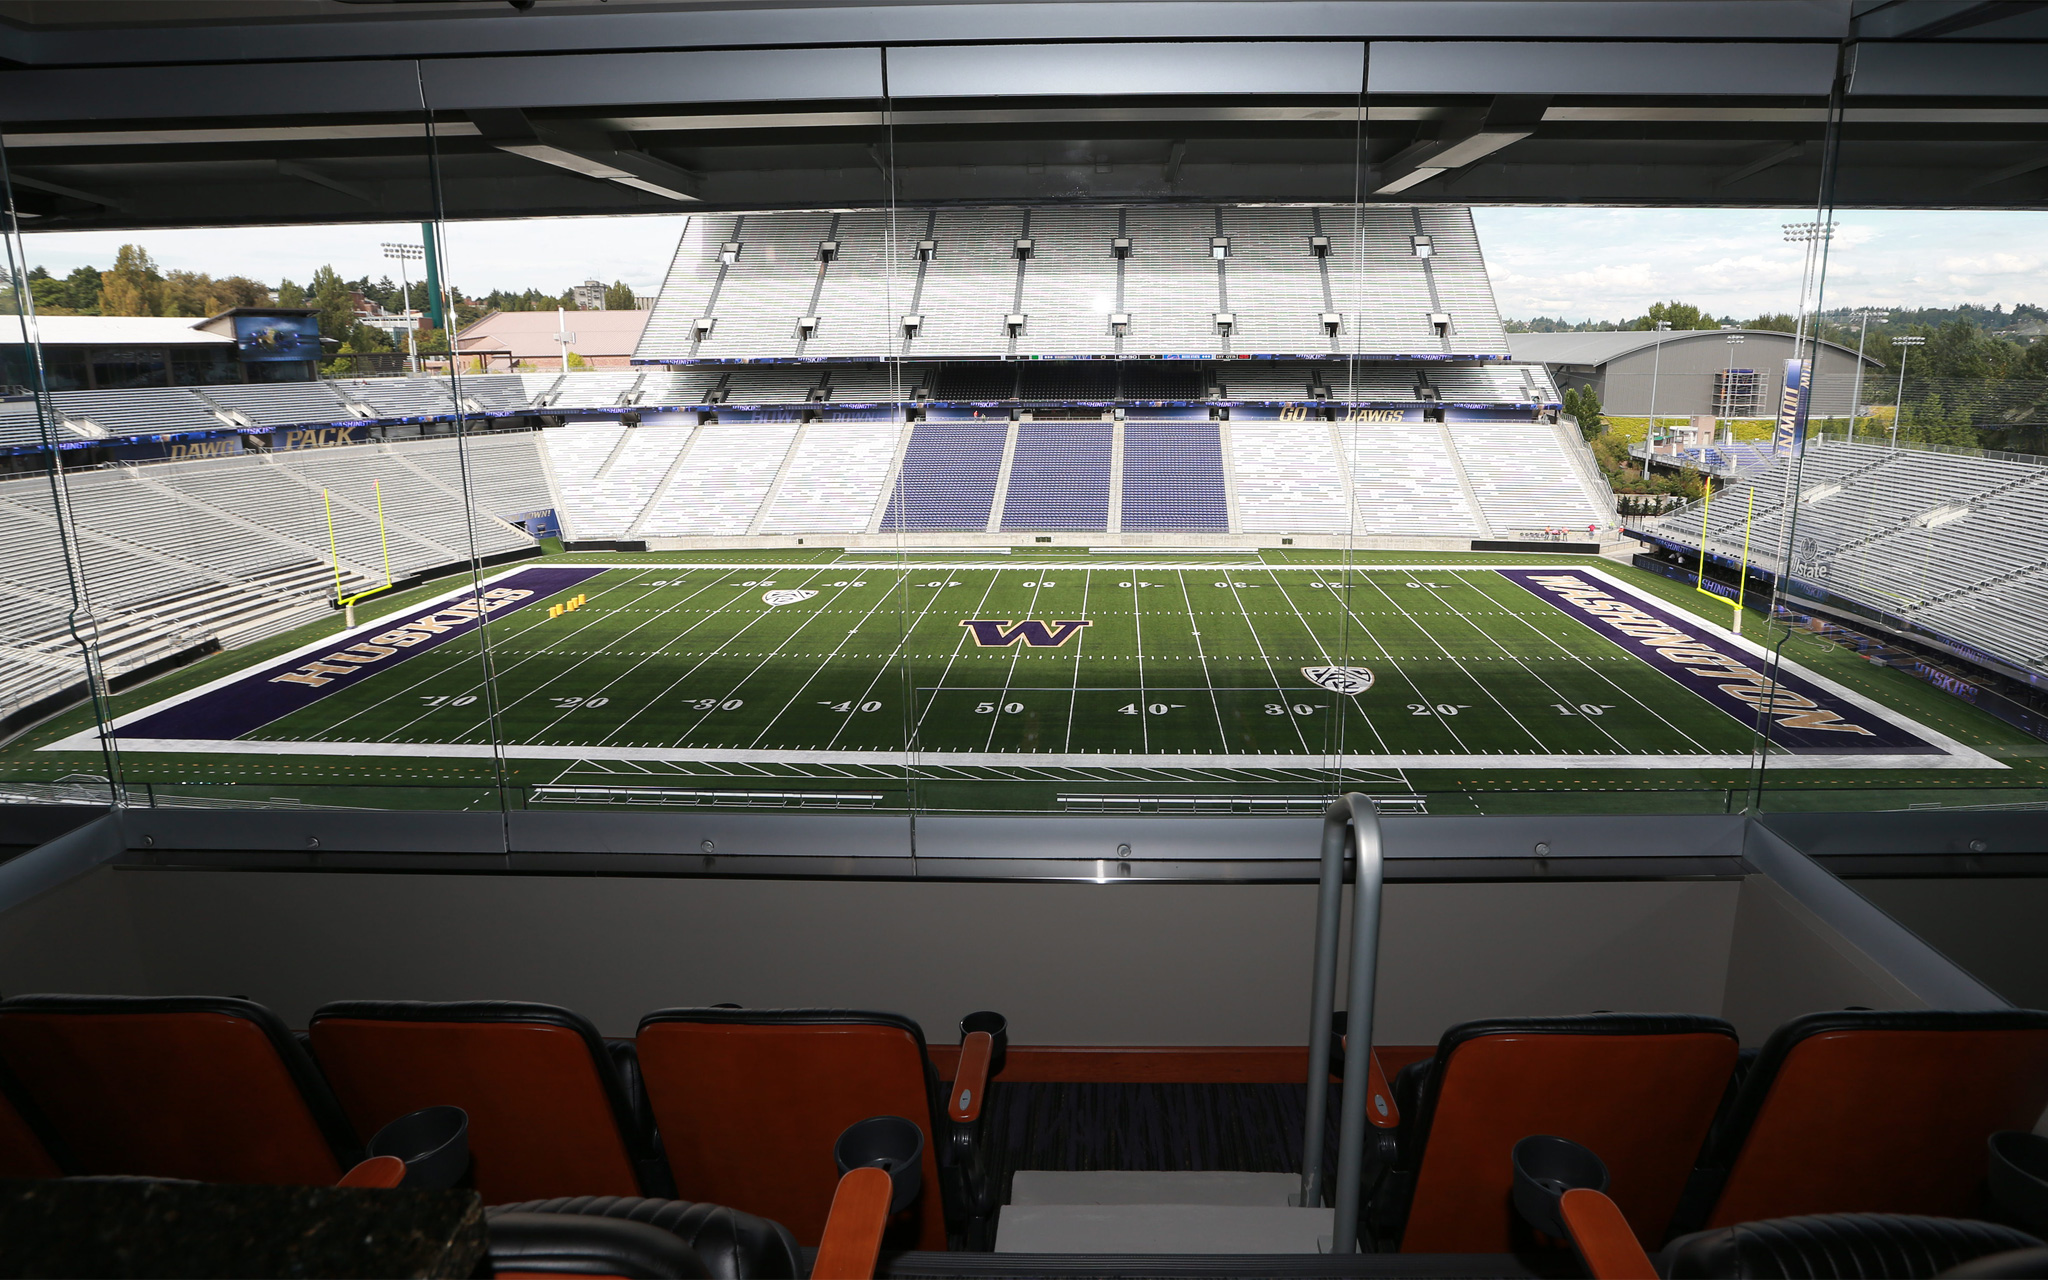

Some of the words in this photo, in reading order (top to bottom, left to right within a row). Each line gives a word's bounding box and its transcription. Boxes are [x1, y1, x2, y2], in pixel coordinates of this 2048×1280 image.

[1279, 406, 1308, 422] GO
[1344, 409, 1404, 423] DAWGS
[169, 440, 235, 462] DAWG
[284, 426, 354, 451] PACK
[1790, 553, 1827, 578] llstate
[1688, 573, 1745, 600] WASHINGTO
[268, 587, 536, 688] HUSKIES
[958, 620, 1093, 647] W
[1525, 575, 1877, 737] WASHINGTON
[423, 695, 477, 707] 10
[555, 696, 610, 709] 20
[693, 697, 744, 711] 30
[829, 699, 882, 712] 40
[974, 702, 1024, 714] 50
[1117, 703, 1168, 715] 40
[1264, 703, 1314, 715] 30
[1406, 703, 1459, 716] 20
[1550, 703, 1604, 716] 10
